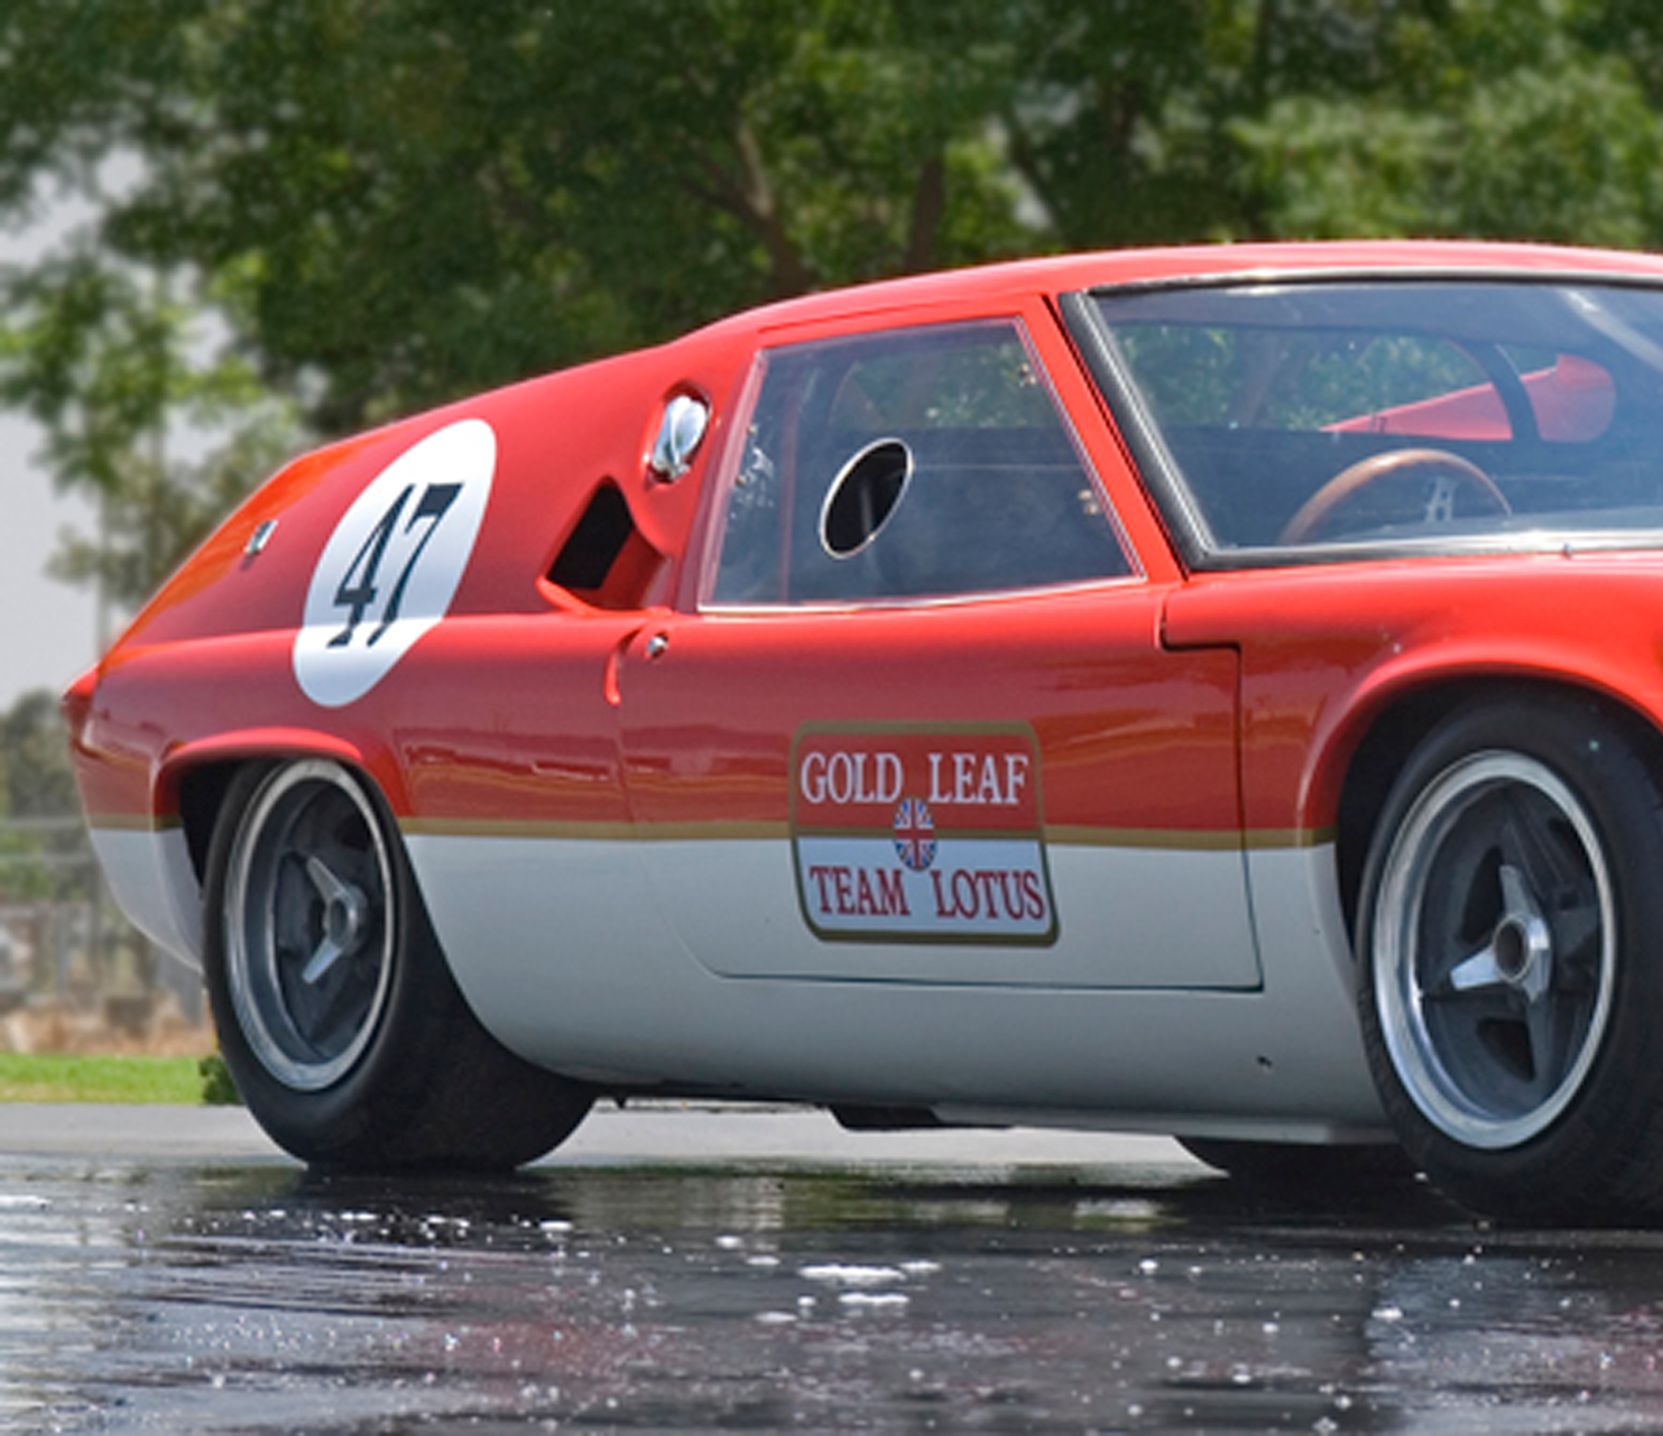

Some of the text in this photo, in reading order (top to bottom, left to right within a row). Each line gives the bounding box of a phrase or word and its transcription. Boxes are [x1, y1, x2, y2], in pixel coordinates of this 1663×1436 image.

[326, 482, 464, 648] 47
[801, 752, 1028, 804] GOLD LEAF
[809, 866, 1045, 919] TEAM LOTUS
